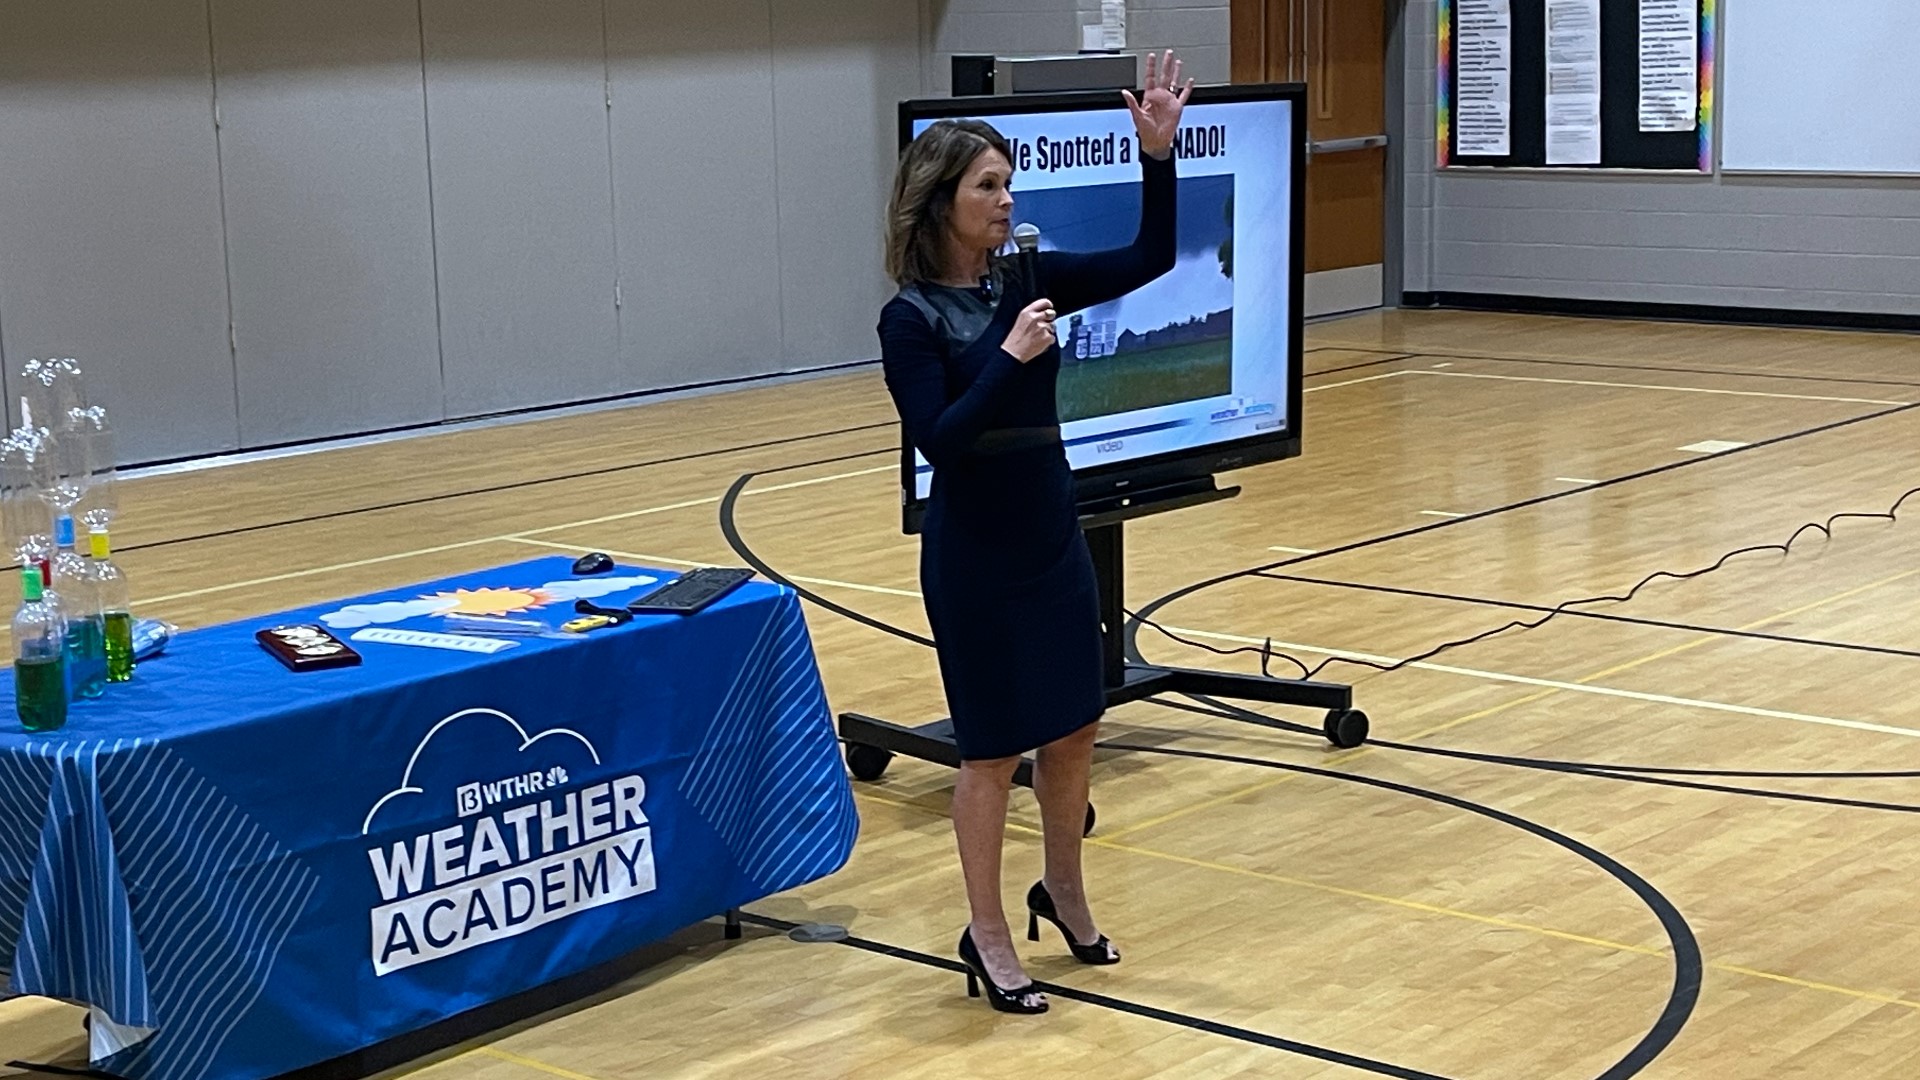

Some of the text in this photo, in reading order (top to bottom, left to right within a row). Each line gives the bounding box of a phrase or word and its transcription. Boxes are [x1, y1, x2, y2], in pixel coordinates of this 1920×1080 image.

[1036, 131, 1115, 173] Spotted
[1120, 136, 1131, 164] a
[1136, 124, 1226, 160] NADO!
[482, 771, 545, 805] WTHR
[367, 774, 650, 901] WEATHER
[380, 838, 646, 964] ACADEMY
